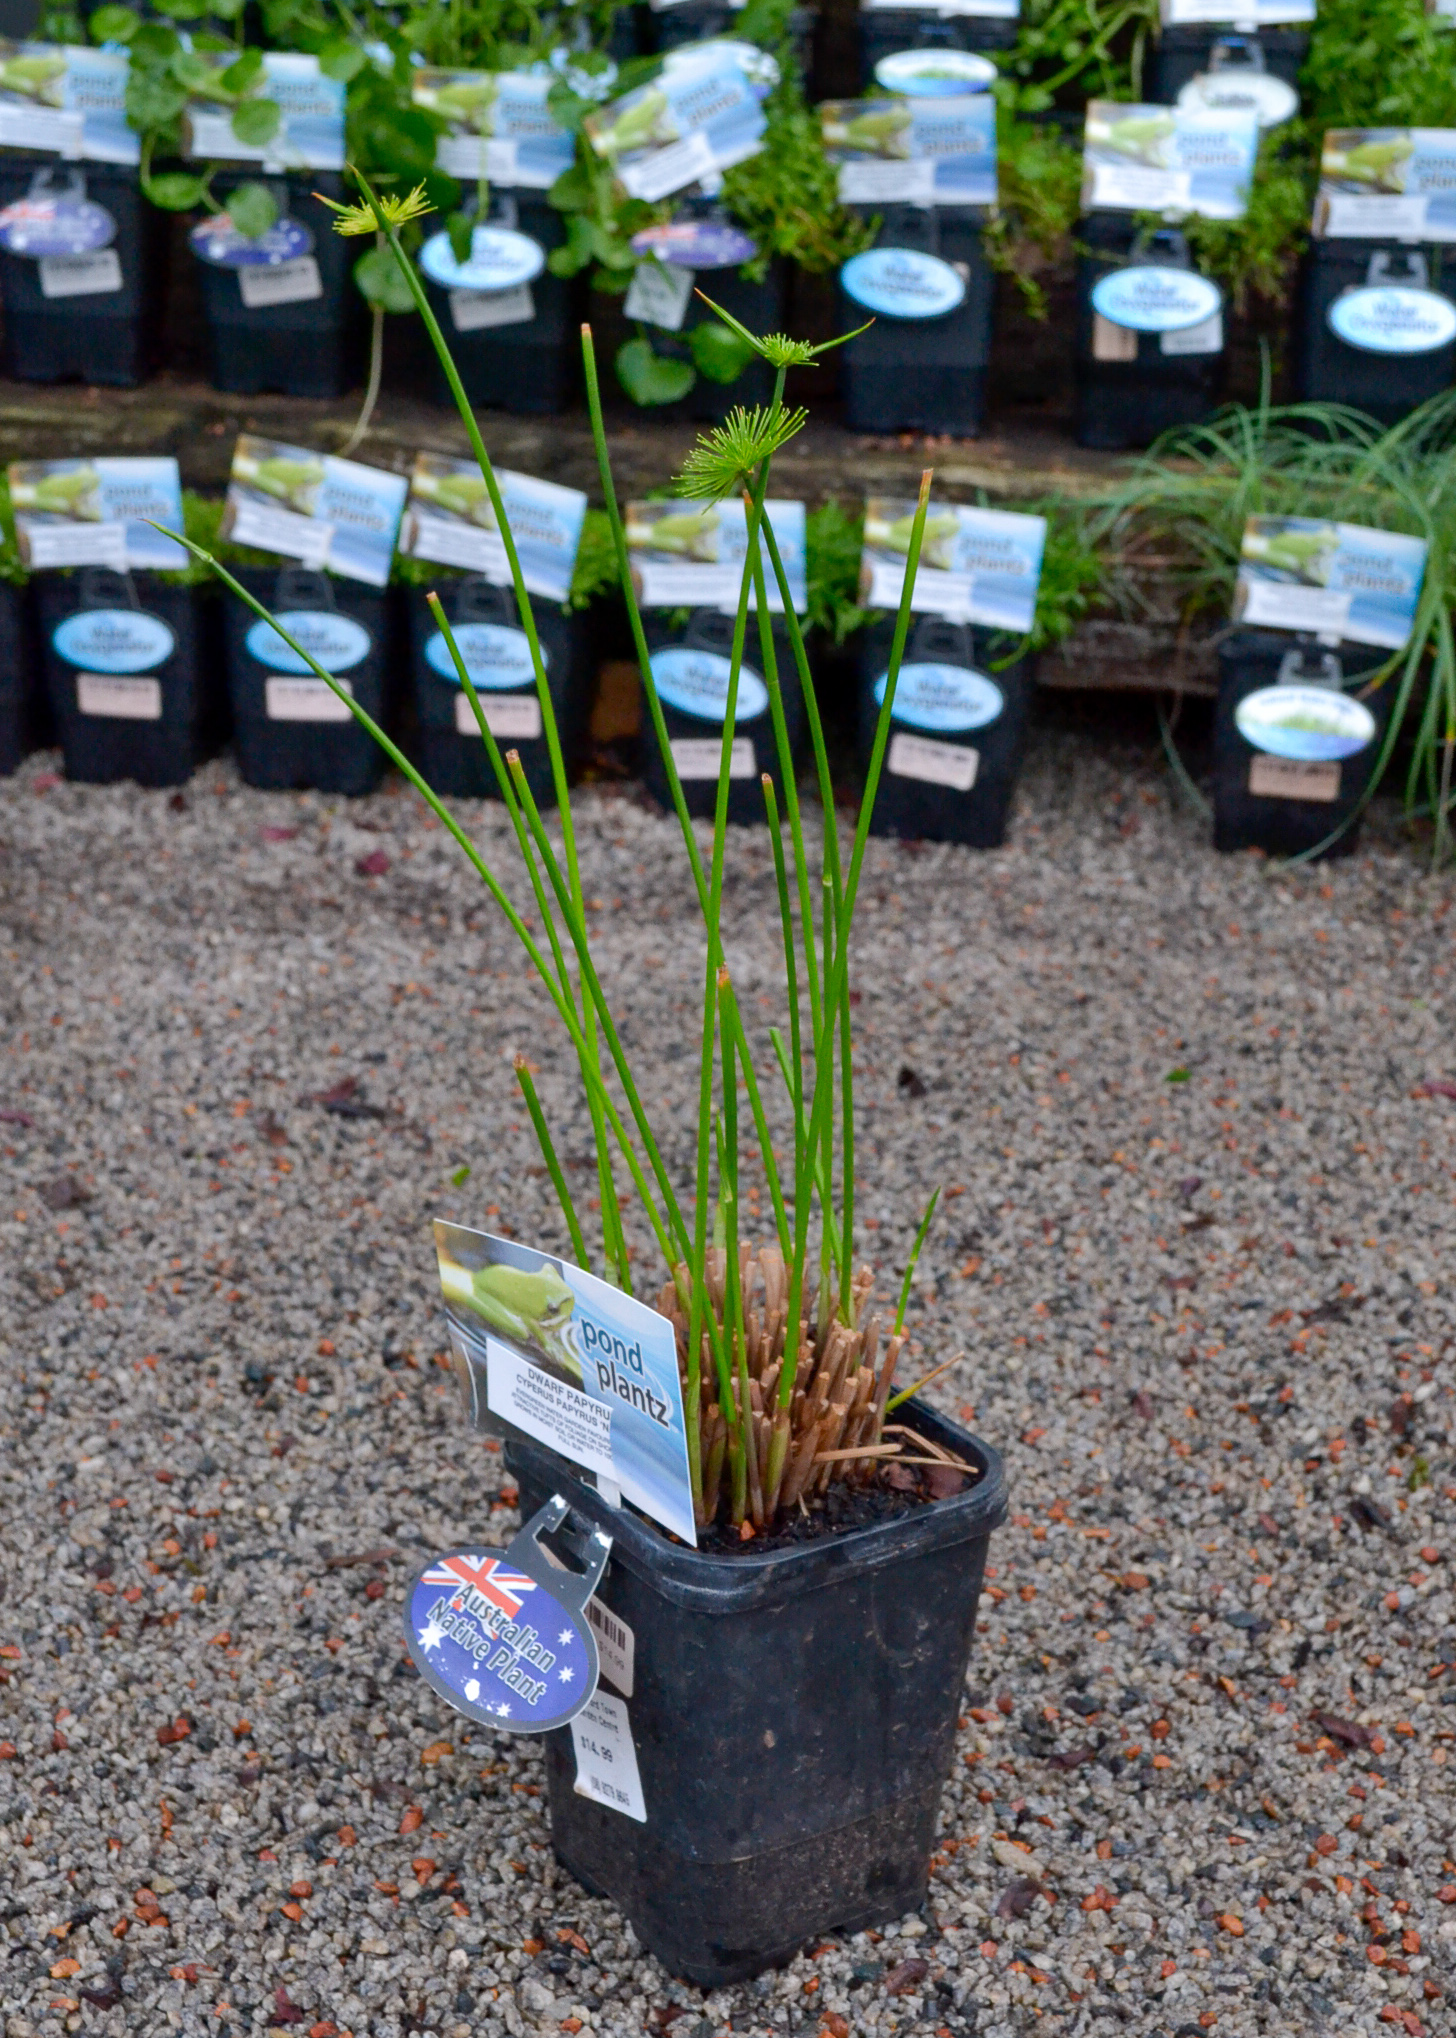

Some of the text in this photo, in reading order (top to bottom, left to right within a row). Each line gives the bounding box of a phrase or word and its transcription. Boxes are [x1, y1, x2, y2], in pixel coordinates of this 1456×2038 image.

[581, 1317, 644, 1375] pond
[516, 1374, 555, 1403] CYPERUS
[556, 1398, 599, 1427] PAPYRUS
[528, 1368, 611, 1421] DWARF PAPYRU
[596, 1360, 670, 1428] plantz
[427, 1598, 491, 1660] Native
[454, 1582, 557, 1675] Australian
[486, 1648, 547, 1707] Plant
